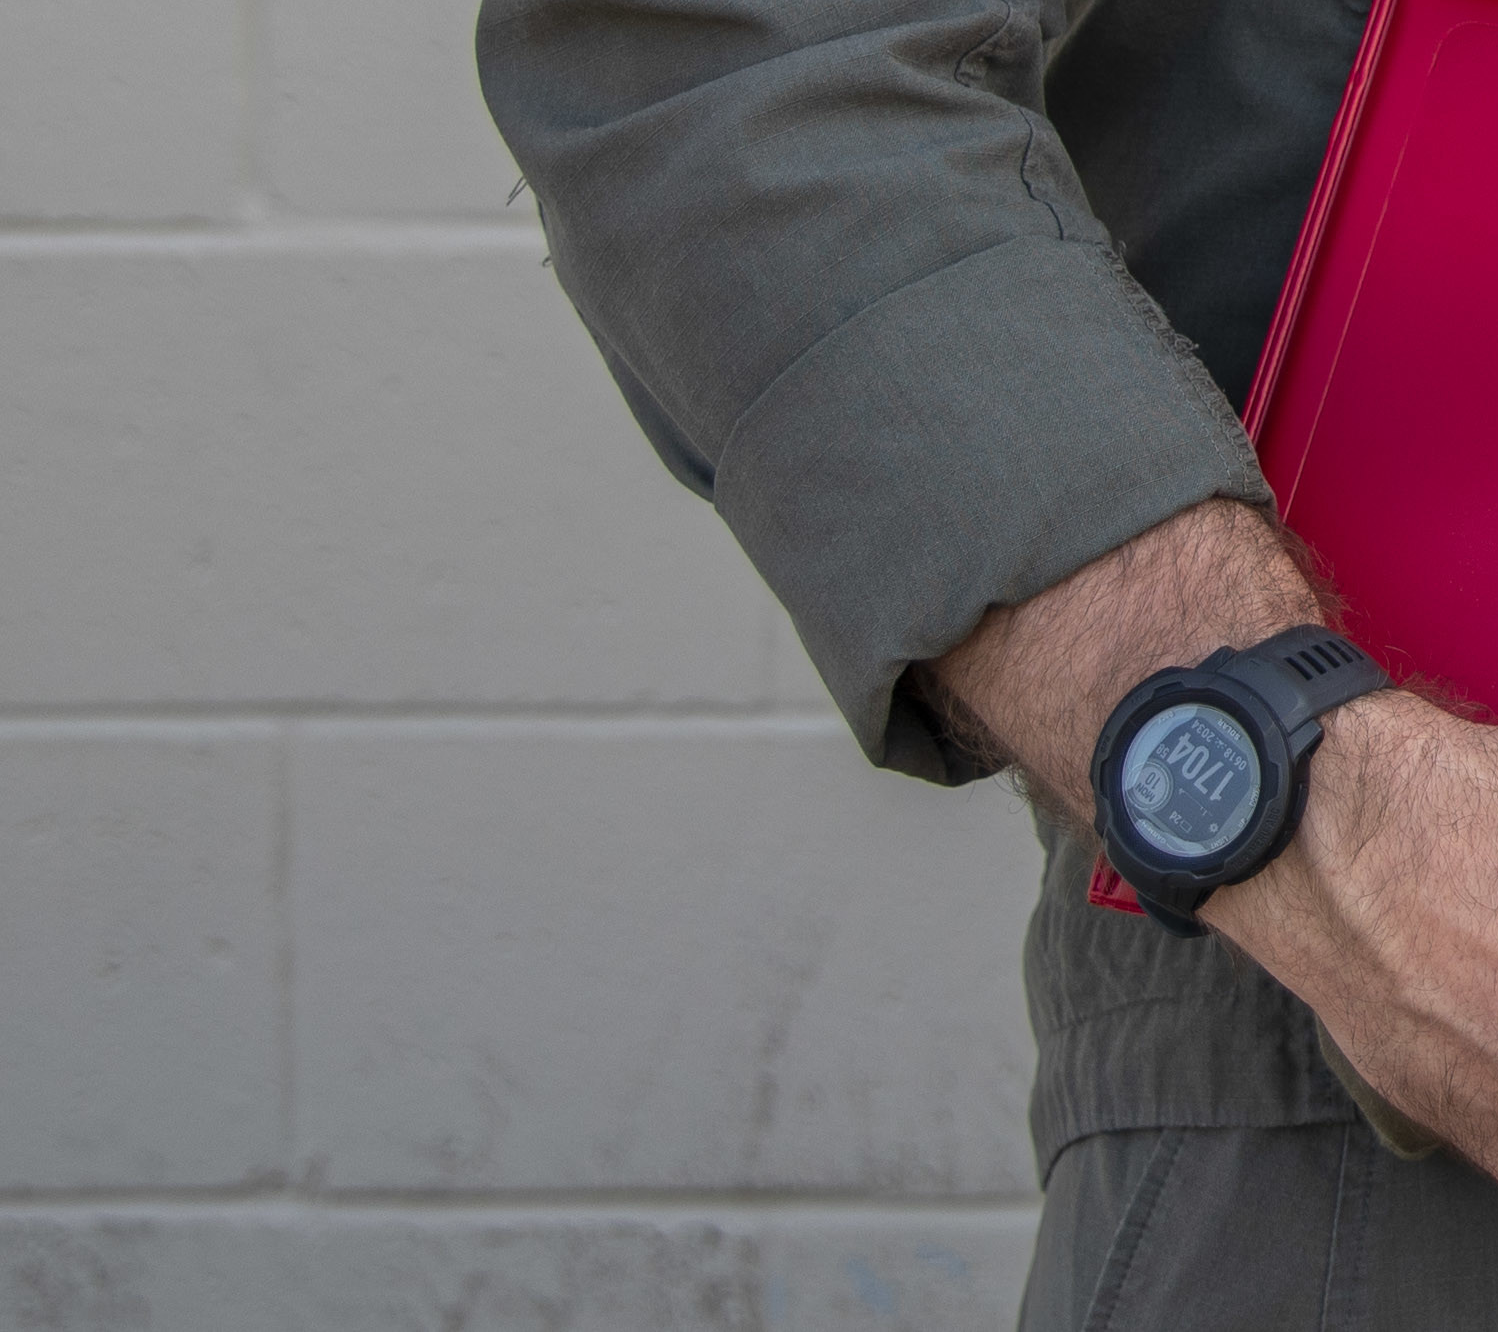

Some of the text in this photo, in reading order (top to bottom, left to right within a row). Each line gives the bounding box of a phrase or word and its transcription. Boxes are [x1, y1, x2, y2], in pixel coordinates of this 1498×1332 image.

[1217, 719, 1241, 741] SOLAR
[1167, 732, 1234, 801] 1704
[1223, 747, 1248, 771] 0618
[1145, 771, 1161, 790] 10
[1135, 782, 1155, 802] MON
